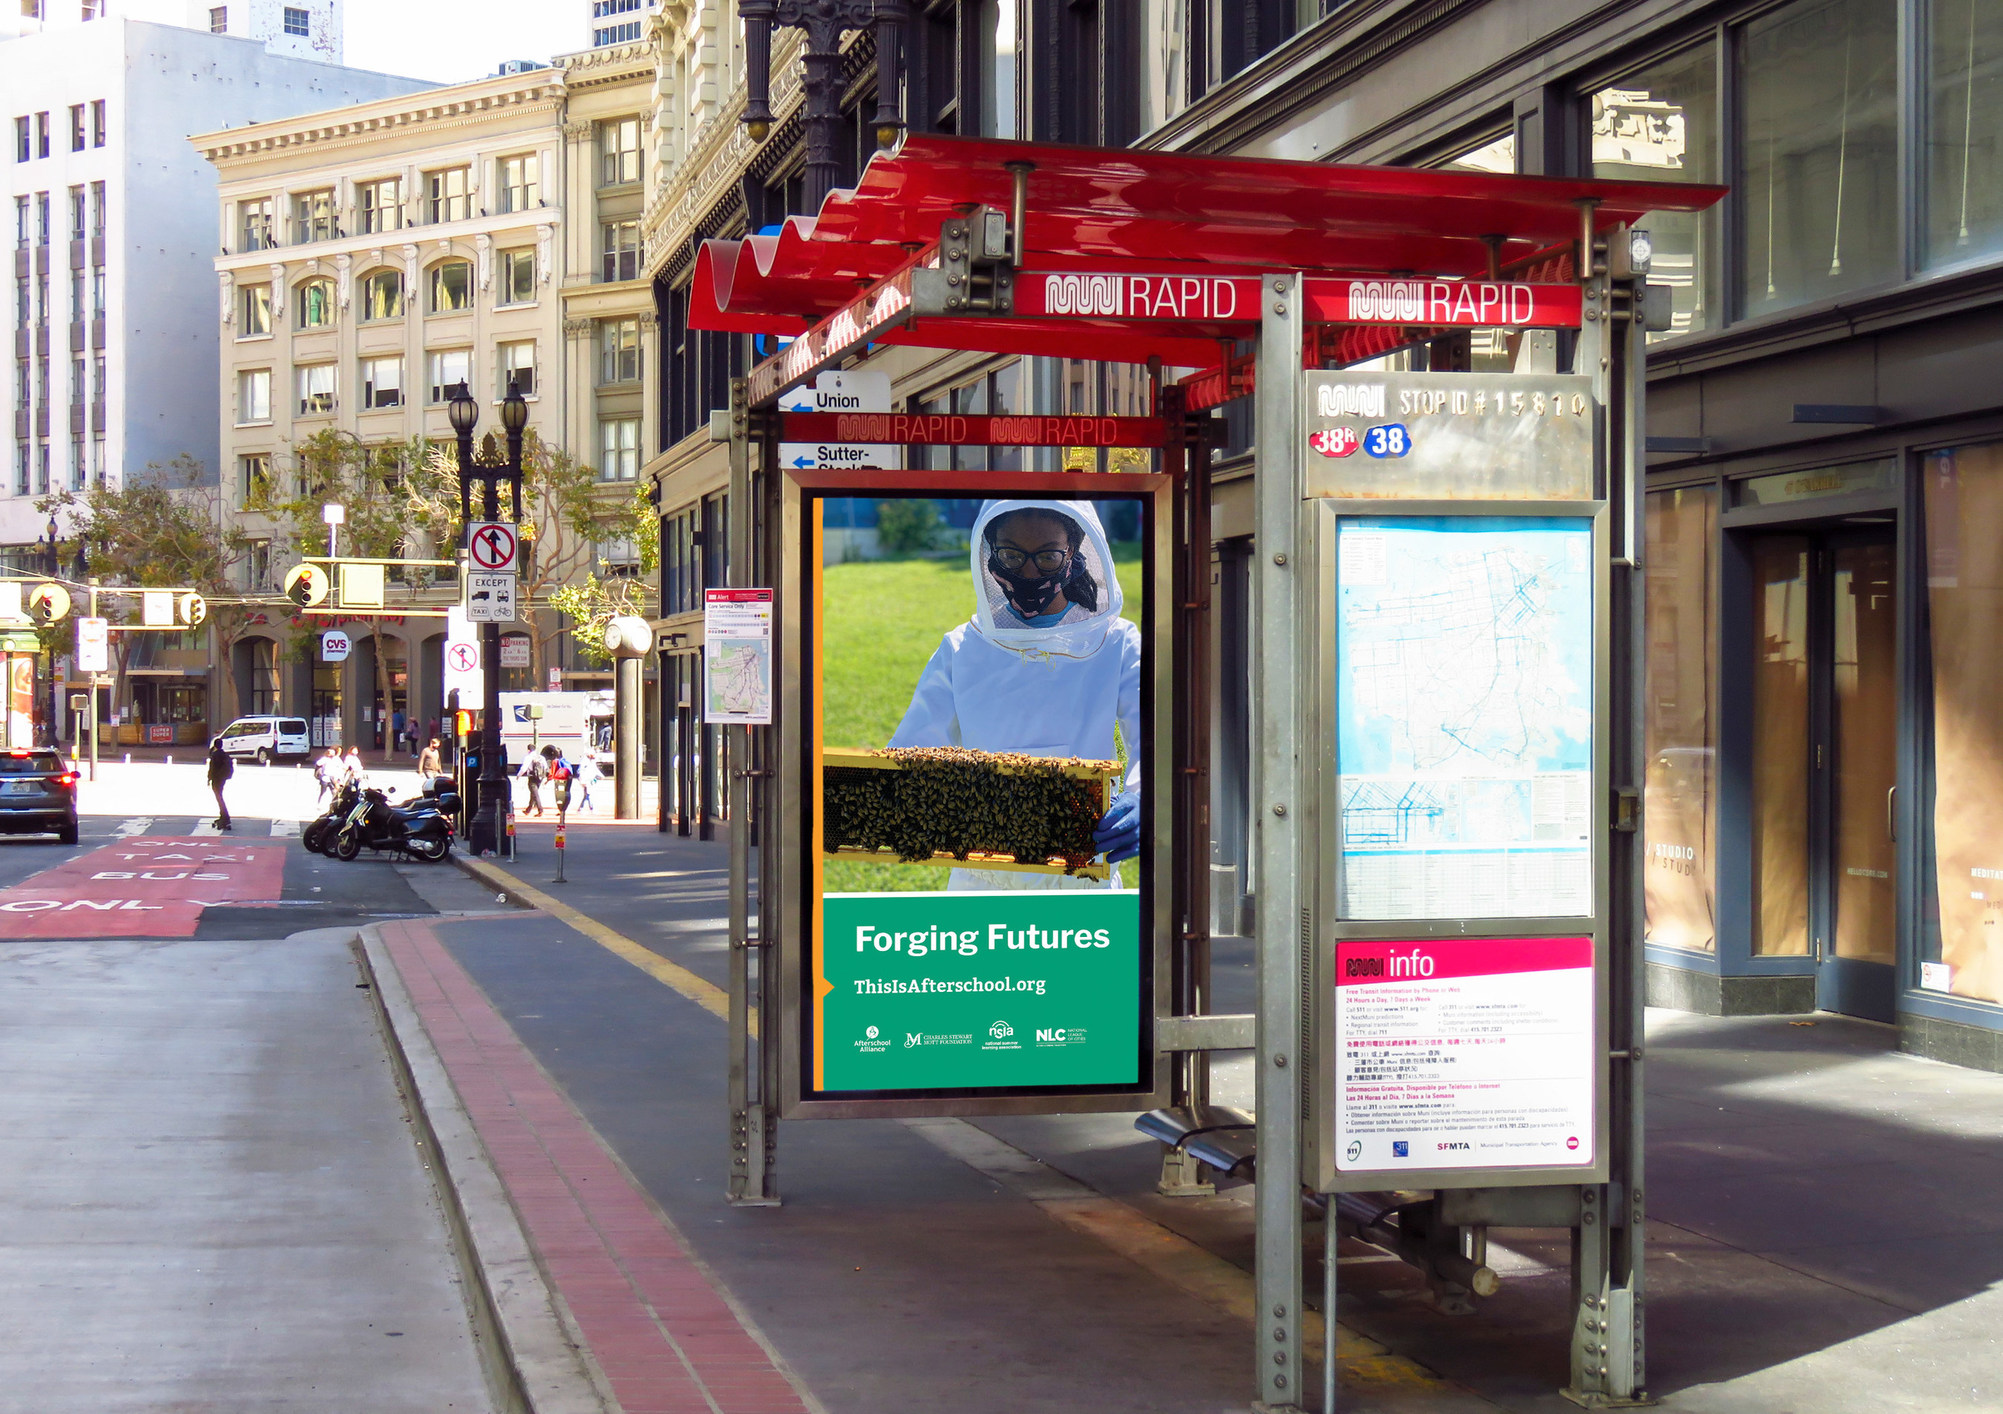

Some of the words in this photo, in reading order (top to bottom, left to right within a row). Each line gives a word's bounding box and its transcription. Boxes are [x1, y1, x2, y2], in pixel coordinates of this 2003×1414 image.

[1130, 277, 1236, 318] RAPID
[1431, 284, 1534, 324] RAPID
[817, 393, 859, 408] Union
[1400, 390, 1446, 415] STOP
[1452, 391, 1467, 415] ID
[894, 415, 966, 442] RAPID
[1047, 417, 1117, 445] RAPID
[1372, 428, 1404, 453] 38
[818, 446, 869, 461] Sutter-
[475, 579, 507, 587] EXCEPT
[326, 639, 347, 649] CVS
[116, 853, 255, 861] TAXI
[1655, 843, 1694, 860] STUDIO
[90, 872, 231, 880] BUS
[856, 925, 980, 957] Forging
[988, 924, 1111, 950] Futures
[1389, 949, 1434, 976] info
[854, 977, 1046, 995] ThisIsAfterschool.org
[989, 1026, 1014, 1039] nsla
[1036, 1028, 1066, 1042] NLC
[1396, 1142, 1408, 1150] 311
